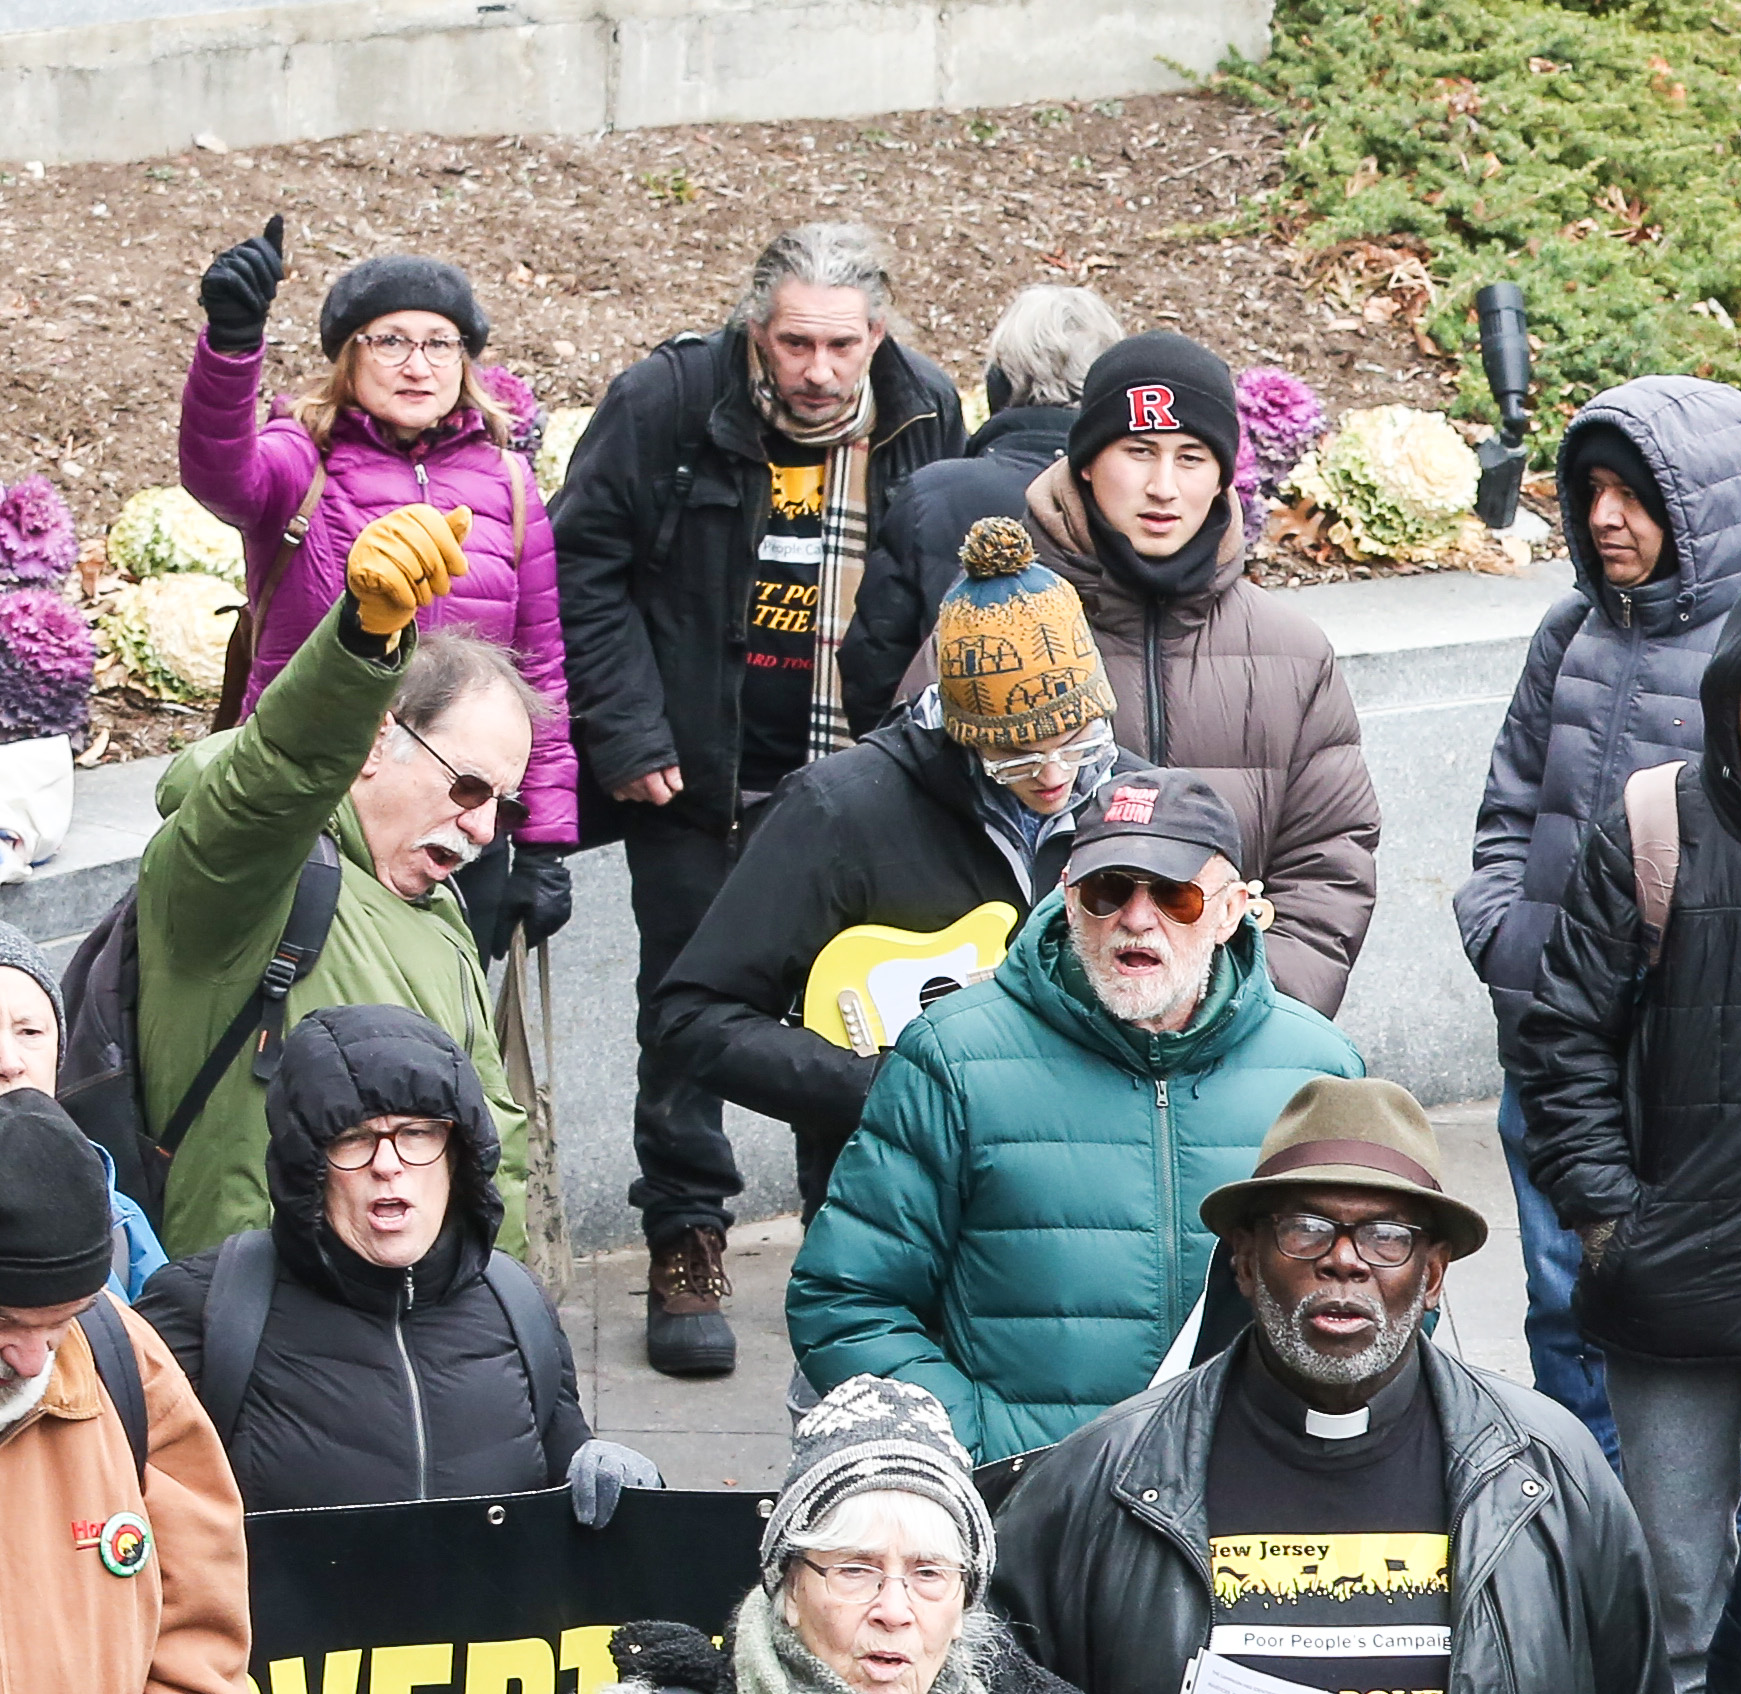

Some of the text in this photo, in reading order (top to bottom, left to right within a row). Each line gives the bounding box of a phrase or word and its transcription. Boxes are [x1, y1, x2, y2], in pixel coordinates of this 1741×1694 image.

[1126, 384, 1181, 432] R
[752, 604, 818, 633] THE
[1103, 803, 1155, 826] ALUM
[1259, 1540, 1330, 1560] Jersey
[1243, 1632, 1285, 1648] Poor
[1290, 1633, 1367, 1651] People's
